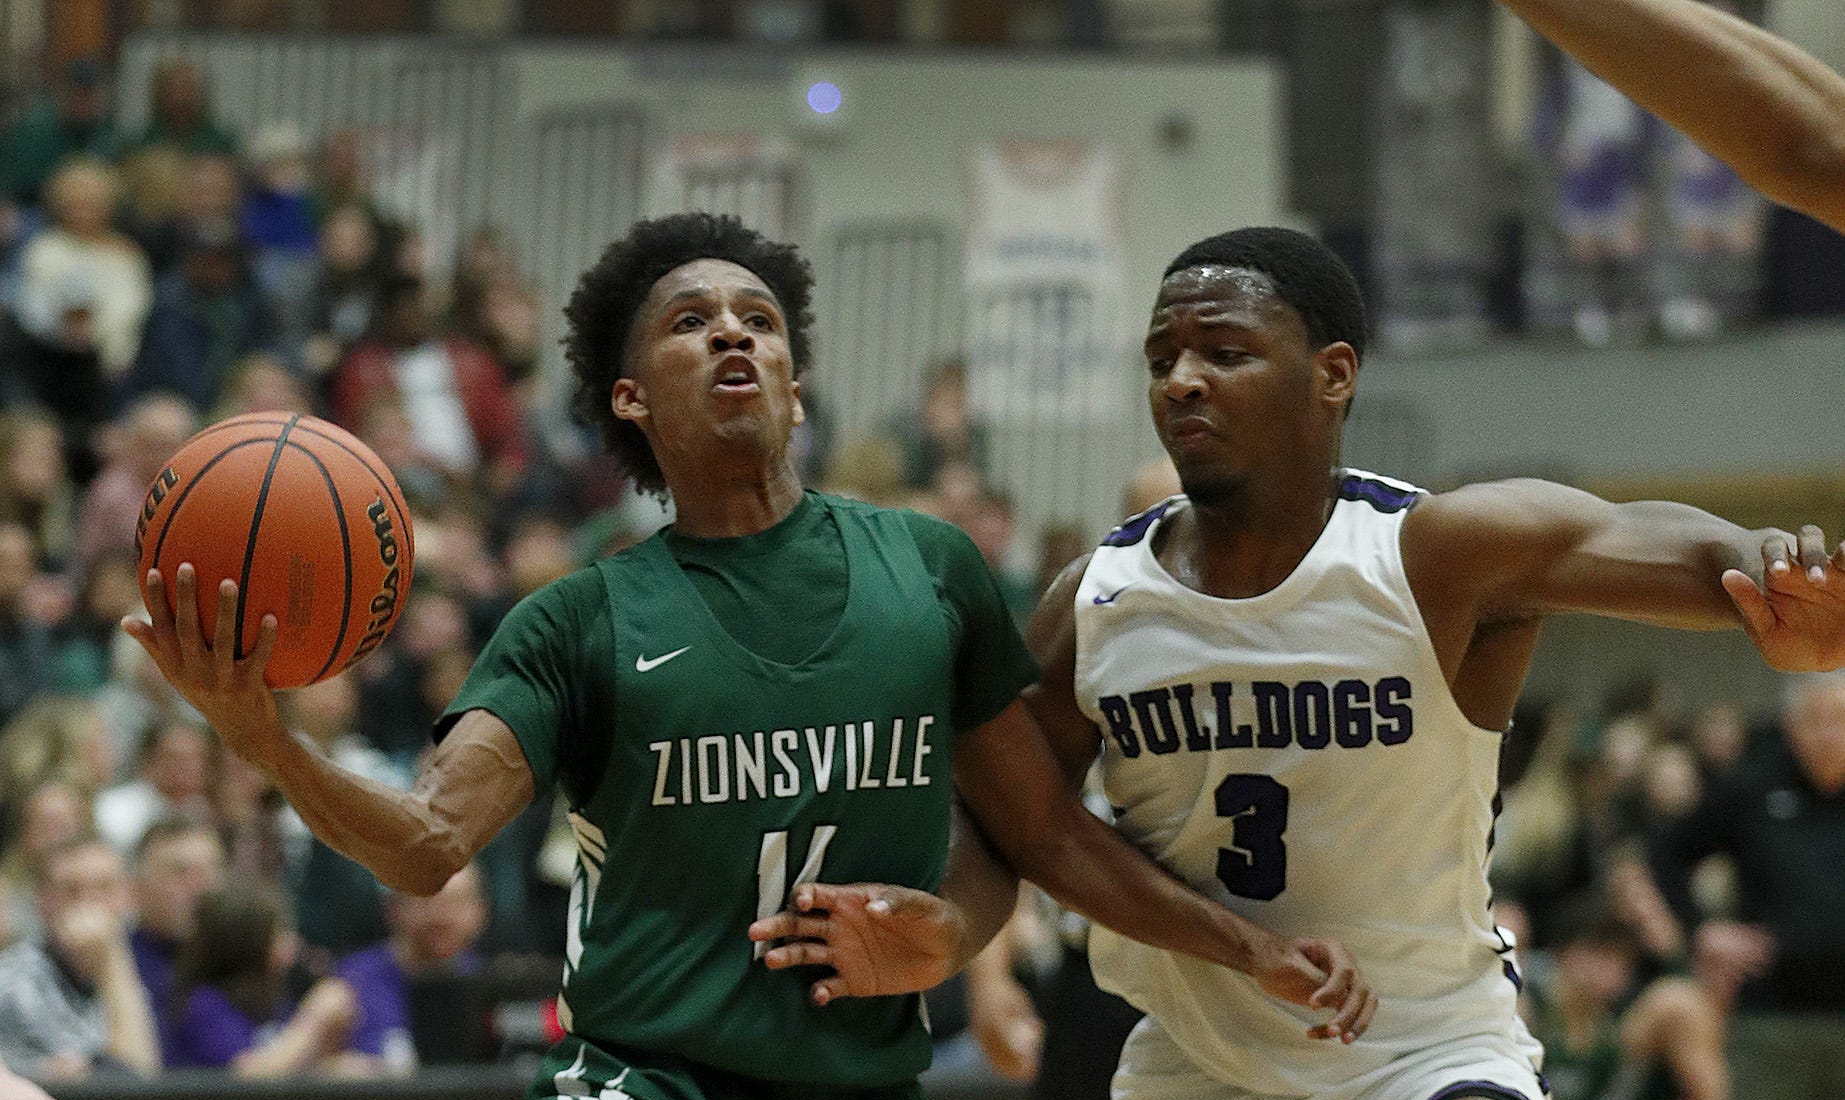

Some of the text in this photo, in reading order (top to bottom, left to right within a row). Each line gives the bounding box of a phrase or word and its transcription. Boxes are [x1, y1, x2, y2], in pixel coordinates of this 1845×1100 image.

[649, 715, 935, 806] ZIONSVILLE
[1099, 675, 1413, 759] BULLDOGS
[1213, 773, 1290, 901] 3
